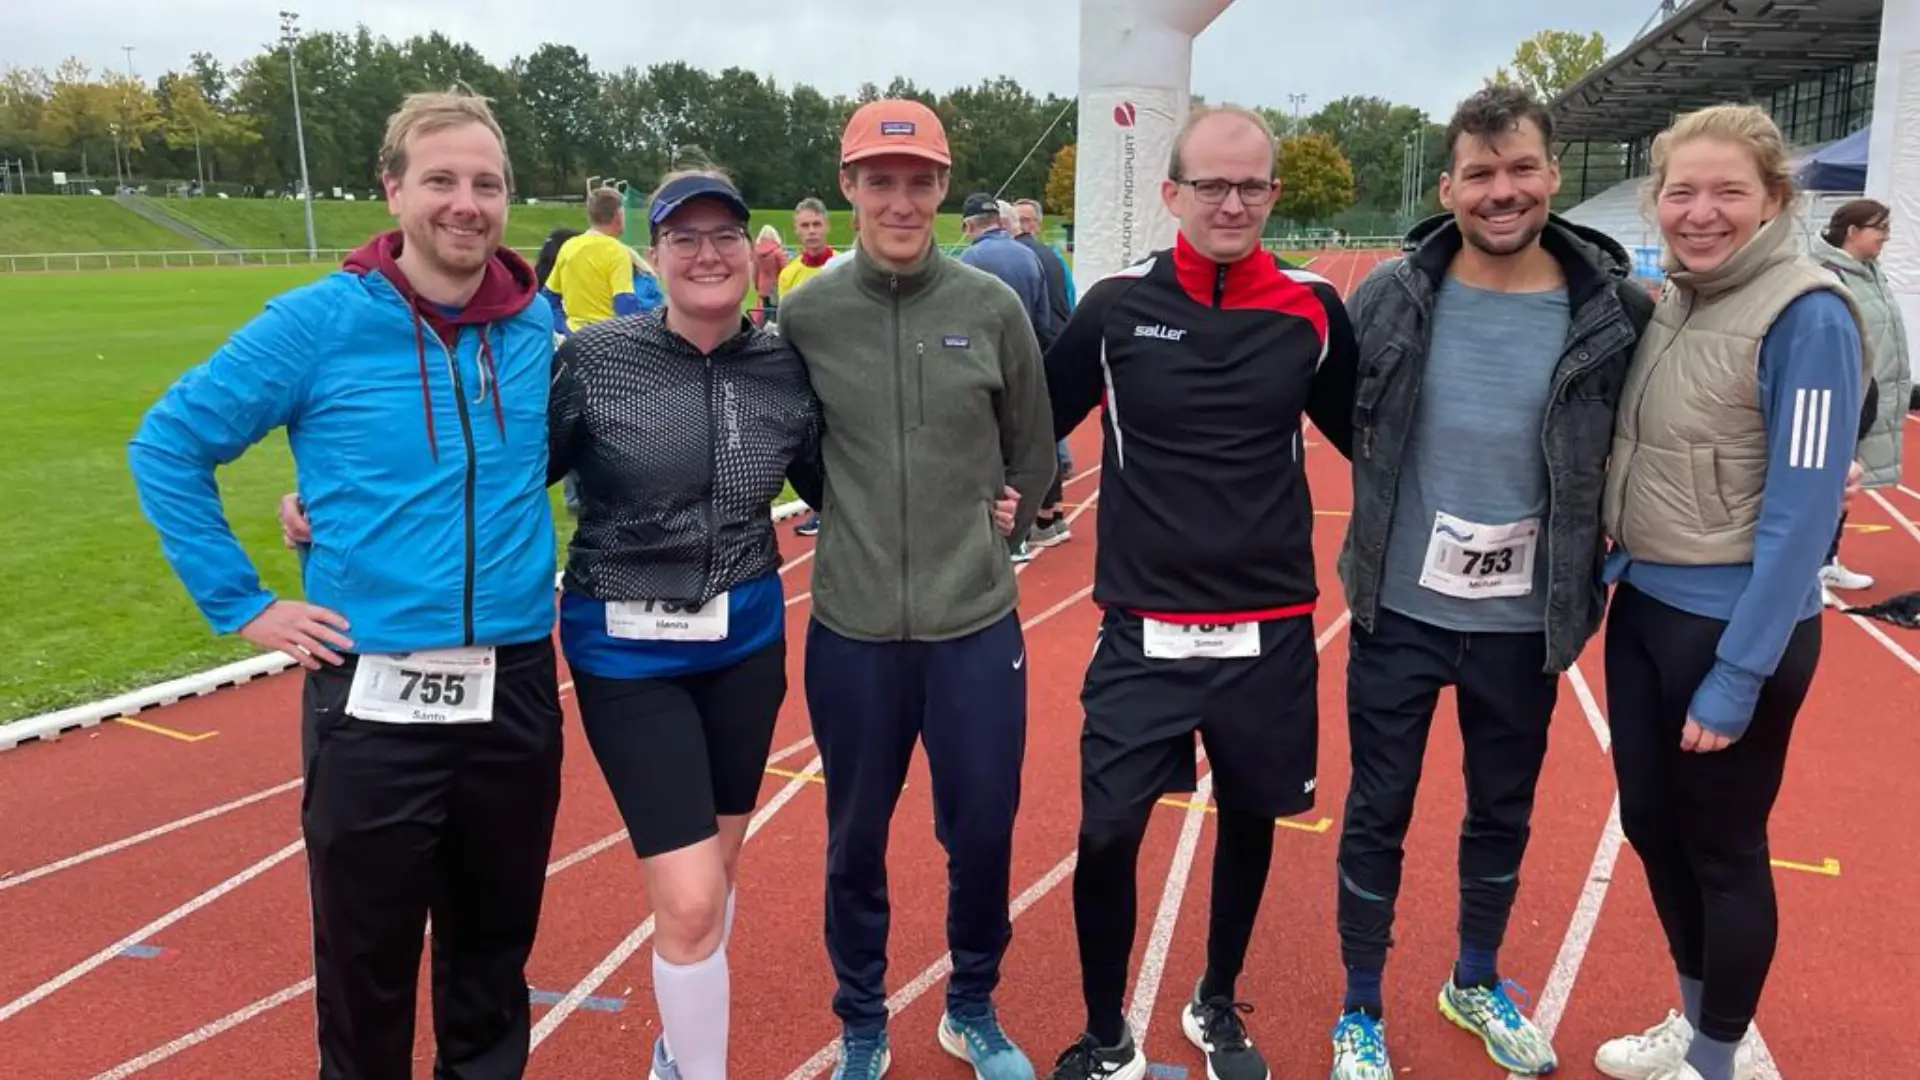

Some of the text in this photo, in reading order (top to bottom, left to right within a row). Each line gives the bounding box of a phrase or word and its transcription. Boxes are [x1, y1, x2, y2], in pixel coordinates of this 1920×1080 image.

[1123, 135, 1136, 207] ENDSPURT
[1133, 324, 1187, 341] saller
[1462, 547, 1513, 575] 753
[399, 669, 465, 706] 755
